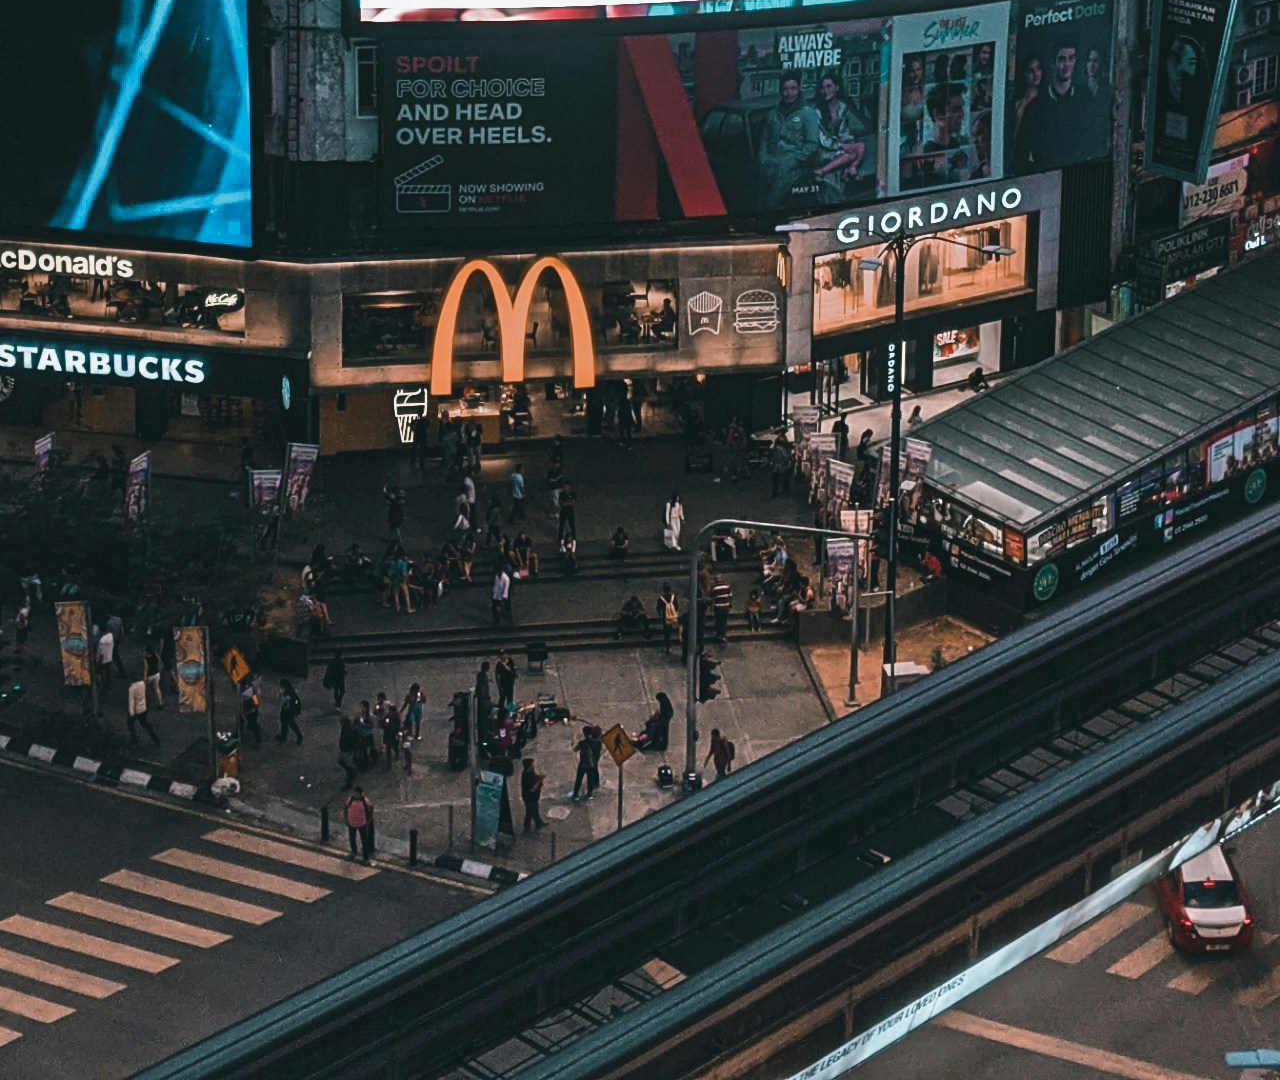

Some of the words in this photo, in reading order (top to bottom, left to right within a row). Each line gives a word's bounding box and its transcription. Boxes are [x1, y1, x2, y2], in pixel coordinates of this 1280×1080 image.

[1025, 7, 1073, 28] Perfect
[1075, 2, 1107, 19] Date
[778, 31, 834, 53] ALWAYS
[396, 55, 482, 73] SPOILT
[793, 48, 842, 69] MAYBE
[396, 79, 447, 98] FOR
[451, 78, 545, 97] CHOICE
[396, 104, 450, 121] AND
[455, 103, 523, 121] HEAD
[396, 127, 463, 145] OVER
[469, 126, 553, 145] HEELS.
[458, 183, 488, 194] NOW
[489, 182, 545, 193] SHOWING
[791, 185, 810, 195] MAY
[458, 195, 477, 205] ON
[936, 329, 958, 346] SALE
[819, 1041, 859, 1071] LEGACY
[859, 1029, 877, 1046] OF
[877, 1008, 904, 1034] YOUR
[904, 991, 939, 1019] LOVED
